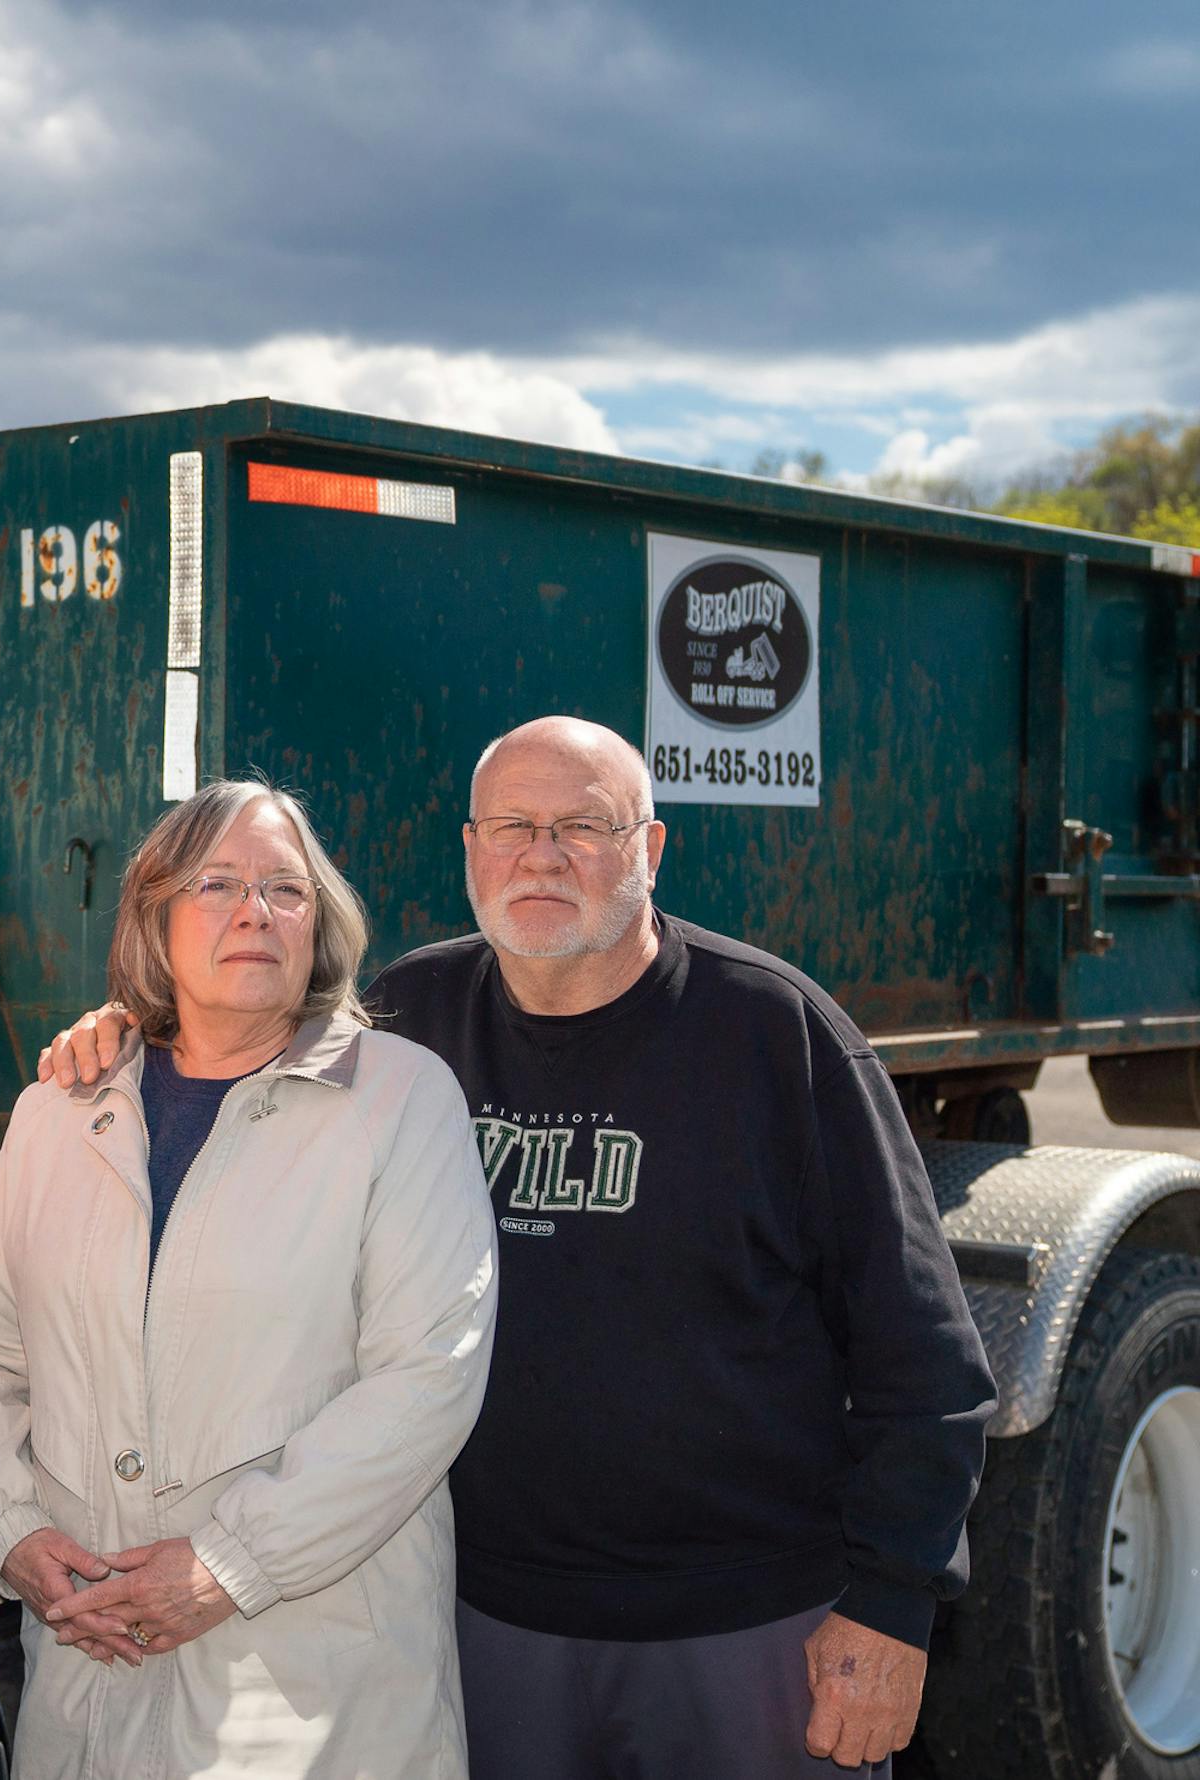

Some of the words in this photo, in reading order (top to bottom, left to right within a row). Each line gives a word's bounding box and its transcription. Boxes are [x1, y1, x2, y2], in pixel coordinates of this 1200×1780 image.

[20, 519, 122, 607] 196
[685, 580, 786, 636] BERQUIST
[687, 640, 718, 659] SINCE
[691, 682, 716, 705] ROLL
[717, 685, 736, 707] OFF
[737, 686, 777, 710] SERVICE
[653, 744, 815, 788] 651-435-3192
[481, 1103, 615, 1124] MINNESOTA
[502, 1220, 529, 1231] SINCE
[530, 1223, 553, 1233] 2000
